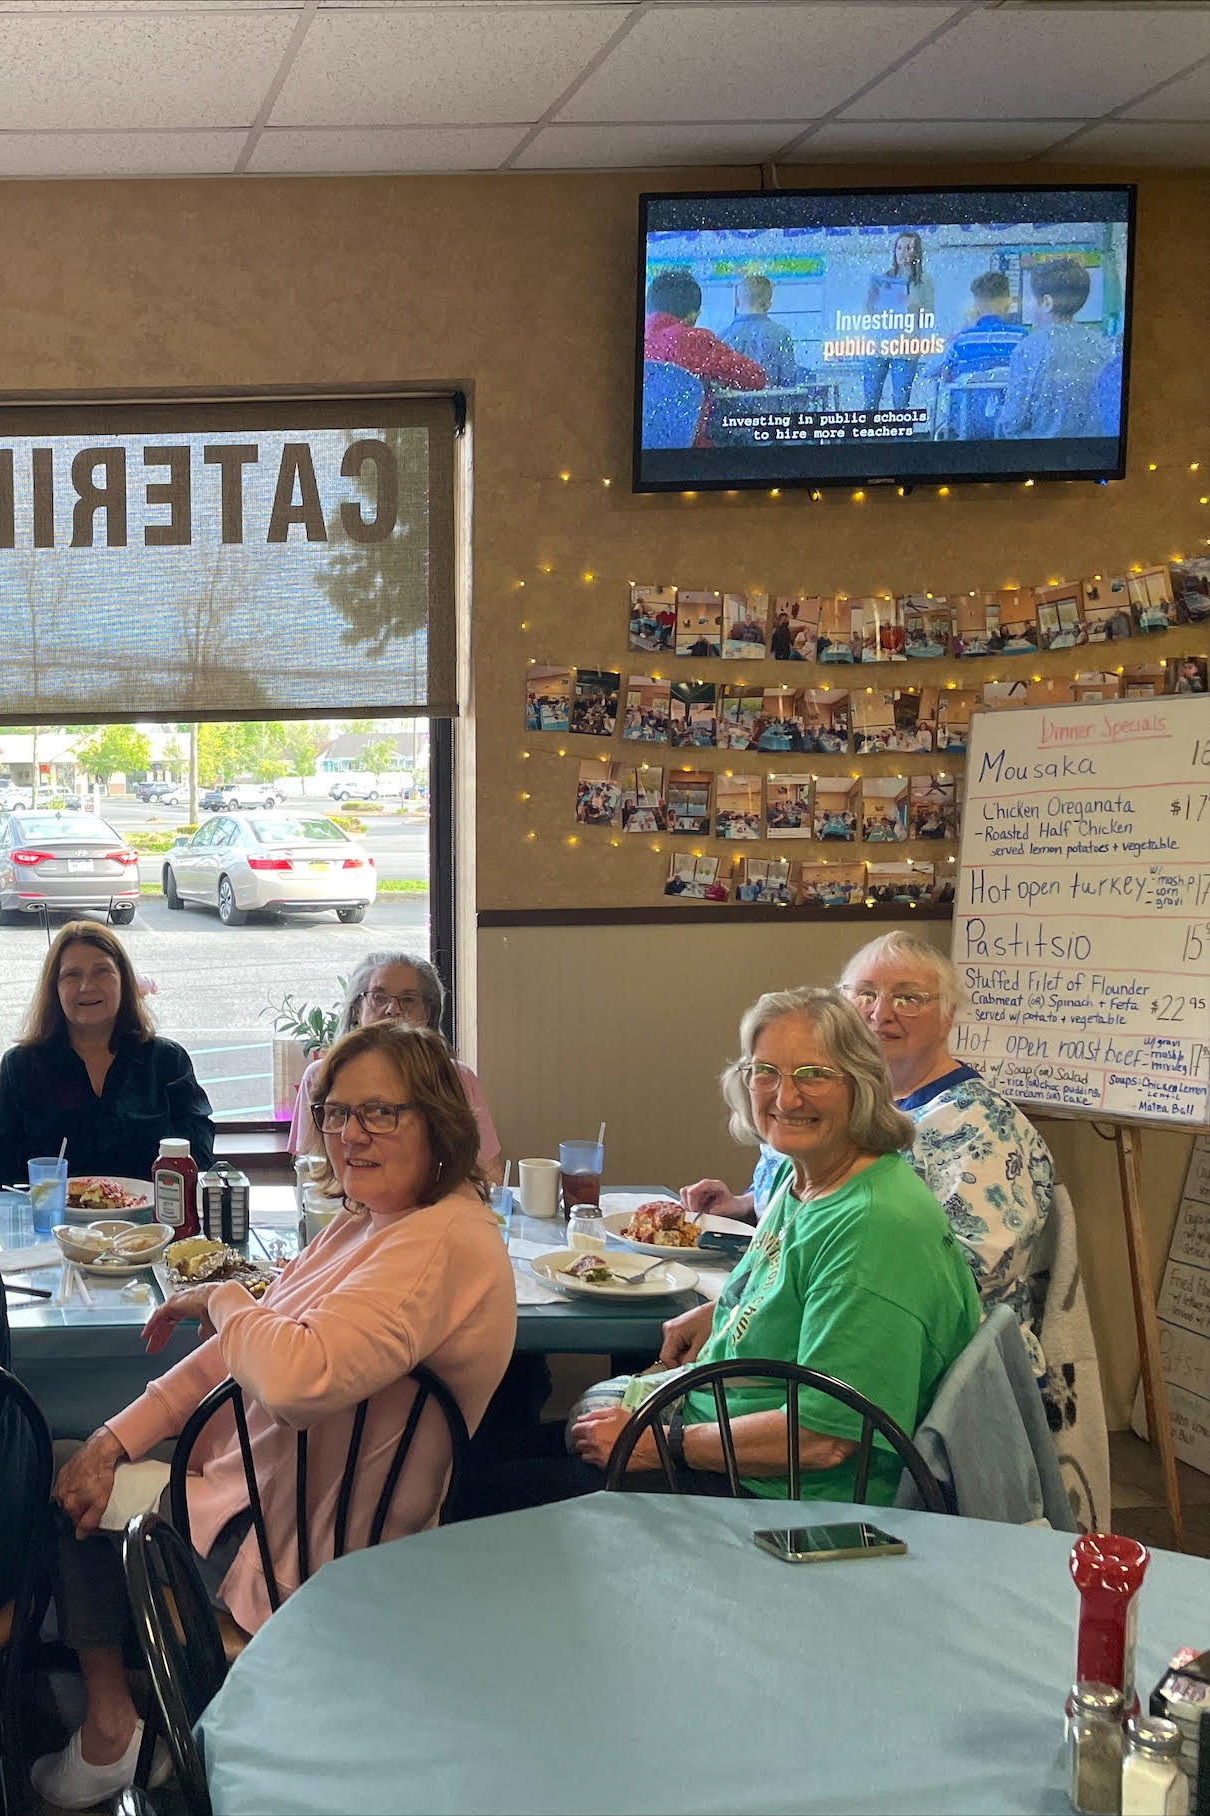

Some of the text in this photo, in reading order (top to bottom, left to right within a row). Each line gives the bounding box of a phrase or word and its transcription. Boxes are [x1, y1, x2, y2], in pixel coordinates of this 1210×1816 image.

[835, 307, 935, 333] Investing in
[823, 333, 945, 361] public schools
[722, 411, 927, 427] investing in public schools
[754, 426, 913, 441] to hire more teachers
[1041, 713, 1167, 744] Dinner Specials
[978, 749, 1097, 783] Mousaka
[983, 802, 1040, 820] Chicken
[1047, 793, 1136, 822] Oreganata
[1039, 820, 1072, 839] Half
[1078, 818, 1133, 837] Chicken
[990, 844, 1025, 857] served
[1030, 842, 1062, 855] lemon
[1066, 840, 1110, 859] potatoes
[1122, 837, 1181, 858] vegetable
[971, 869, 1147, 907] Hot open turkey
[966, 918, 1091, 961] Pastitsio
[965, 967, 1020, 991] Stuffed
[1028, 969, 1063, 992] Filet
[1066, 972, 1086, 992] of
[1091, 974, 1151, 996] Flounder
[971, 991, 1024, 1008] Crabmeat
[1048, 993, 1094, 1012] Spinach
[1022, 1012, 1058, 1025] potato
[1070, 1013, 1127, 1032] vegetable
[956, 1025, 1144, 1067] Hot open roast beef
[1005, 1062, 1033, 1079] Soup
[1054, 1067, 1089, 1085] Salad
